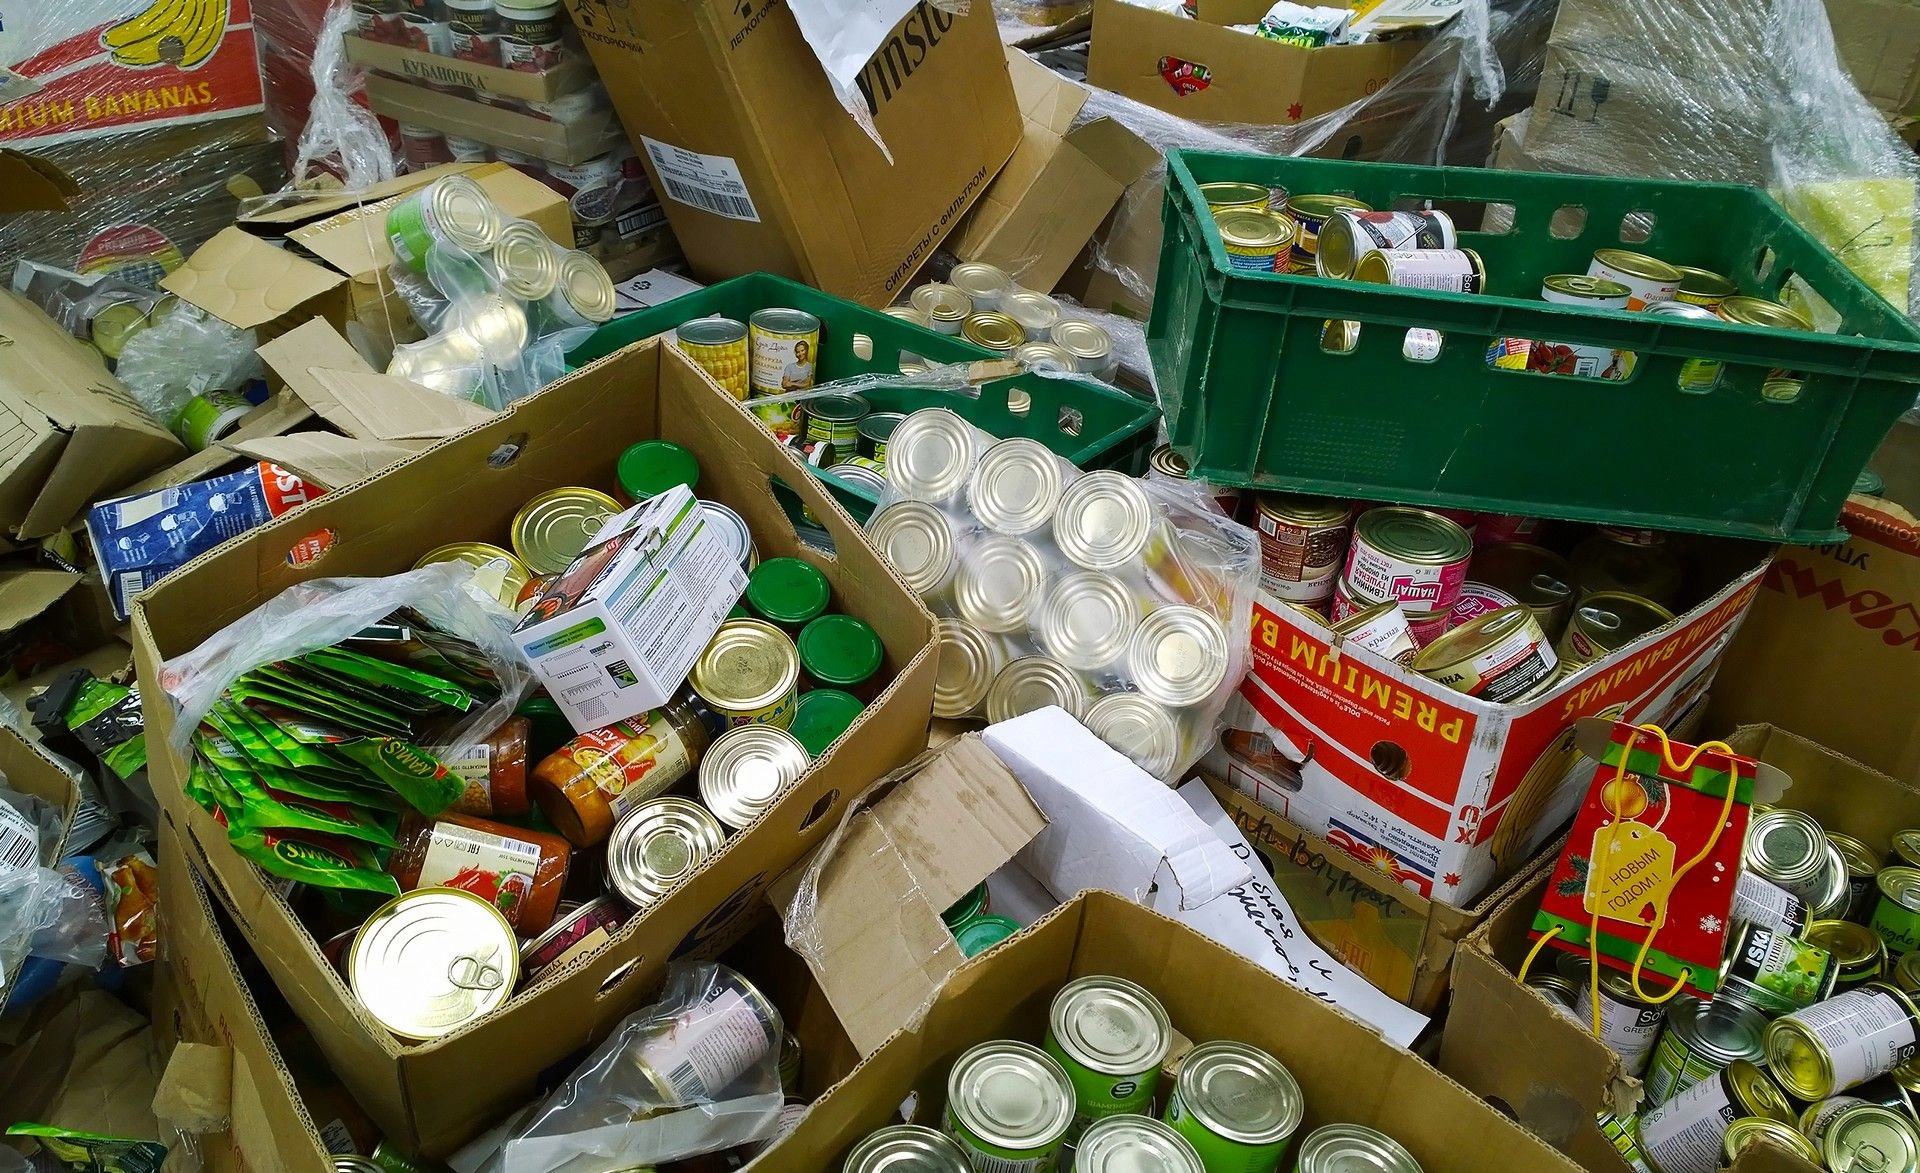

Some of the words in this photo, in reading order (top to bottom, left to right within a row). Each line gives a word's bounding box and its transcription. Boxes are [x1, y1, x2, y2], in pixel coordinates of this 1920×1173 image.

[402, 59, 486, 90] КУБАНОЧКА
[85, 82, 212, 121] BANANAS
[885, 233, 932, 292] СИГАРЕТЫ
[940, 165, 988, 226] ФИЛЬТРОМ
[1290, 635, 1464, 744] PREMIUM
[1561, 636, 1682, 722] BANANAS
[385, 740, 432, 776] KAMIS
[1609, 848, 1661, 887] НОВЫМ
[1608, 876, 1656, 912] ГОДОМ
[1745, 929, 1772, 968] ISKA
